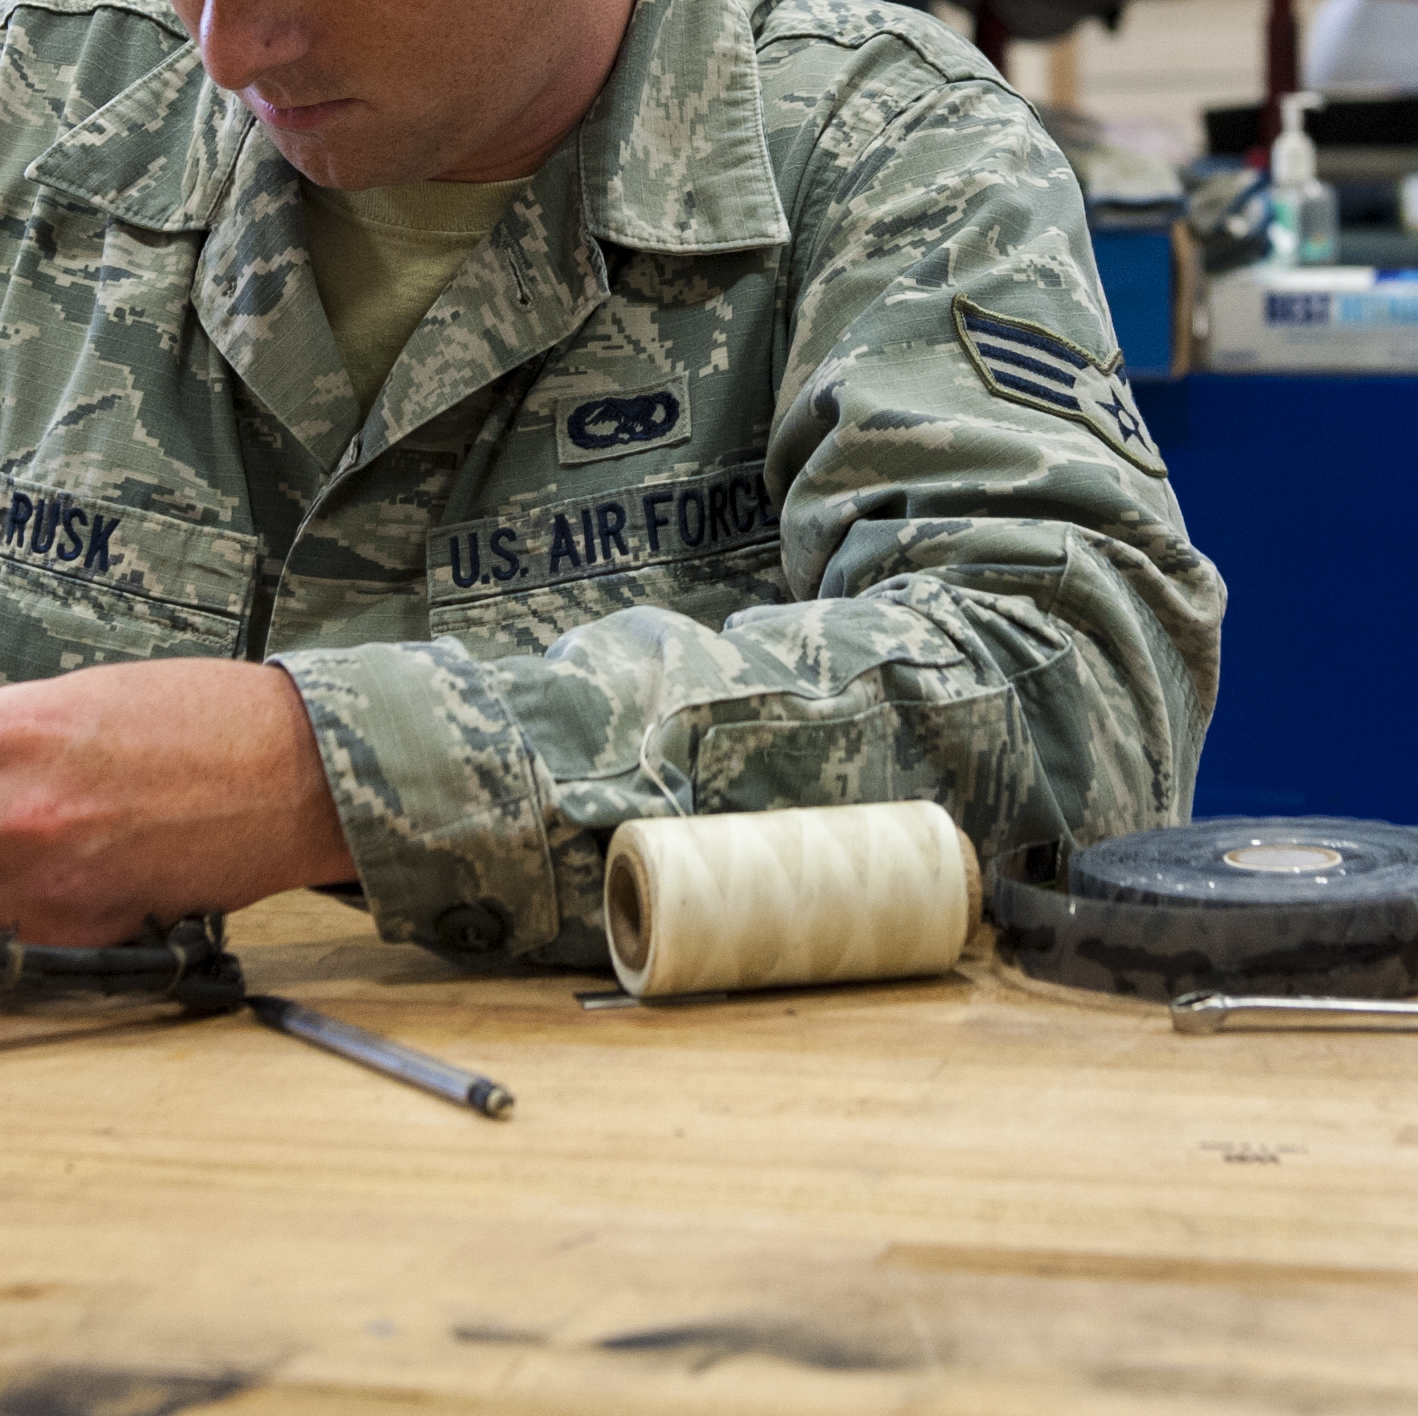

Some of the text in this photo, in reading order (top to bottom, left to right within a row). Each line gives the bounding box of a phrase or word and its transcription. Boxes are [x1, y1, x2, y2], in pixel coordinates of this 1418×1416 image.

[6, 491, 121, 573] RUSK
[449, 527, 529, 589] U.S.
[549, 500, 630, 573] AIR
